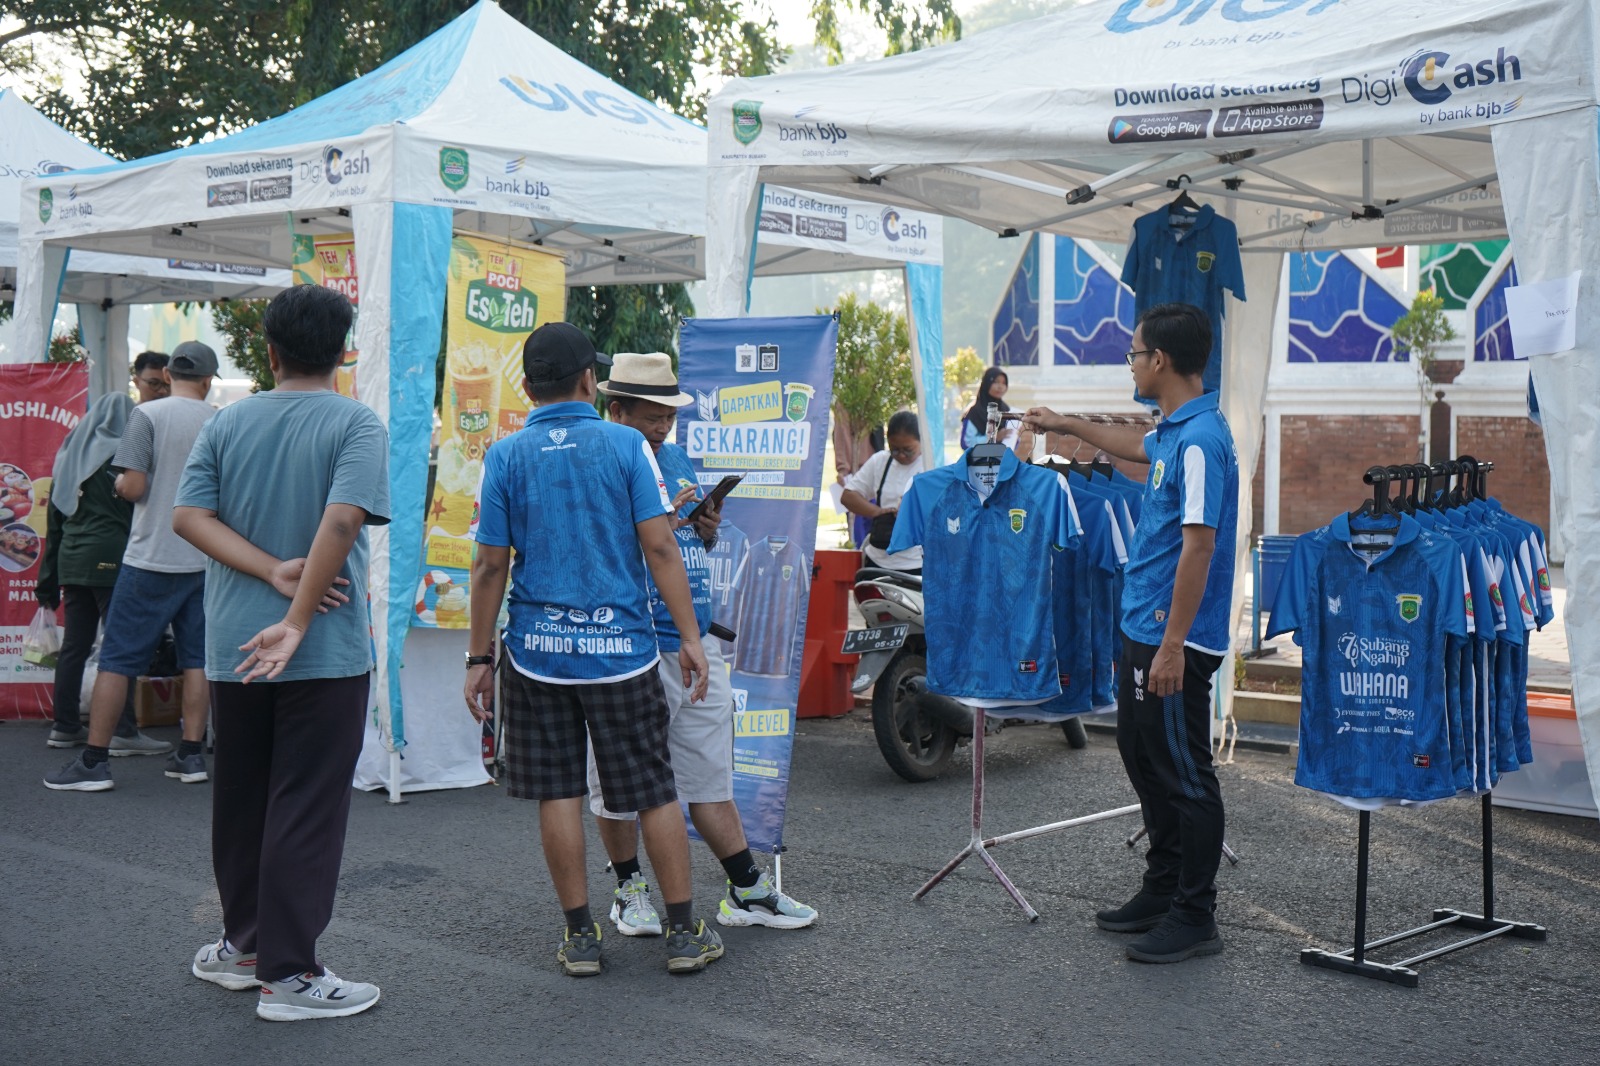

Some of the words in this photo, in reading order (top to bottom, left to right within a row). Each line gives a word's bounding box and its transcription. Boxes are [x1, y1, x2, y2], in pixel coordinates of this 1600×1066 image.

[1114, 82, 1215, 107] Download
[1244, 106, 1285, 117] Available
[1299, 102, 1314, 111] the
[1420, 112, 1435, 125] by
[1438, 106, 1472, 122] bank
[1475, 102, 1502, 119] bjb
[1137, 123, 1176, 138] Google
[1177, 121, 1202, 135] Play
[1241, 116, 1273, 132] App
[1275, 113, 1314, 127] Store
[779, 124, 817, 142] bank
[817, 123, 847, 144] bjb
[802, 149, 825, 158] Cabang
[826, 149, 849, 158] Subang
[206, 160, 250, 179] Download
[251, 156, 294, 173] sekarang
[260, 187, 274, 198] App
[273, 184, 289, 196] Store
[486, 176, 520, 194] bank
[524, 179, 550, 199] bjb
[218, 192, 235, 202] Google
[235, 191, 245, 201] Play
[78, 202, 93, 218] bjb
[798, 198, 848, 219] sekarang
[809, 225, 824, 237] App
[824, 226, 844, 238] Store
[319, 250, 338, 264] TEH
[490, 255, 504, 264] TEH
[488, 272, 519, 290] POCI
[468, 288, 490, 321] Es
[502, 292, 534, 328] Teh
[722, 391, 780, 415] DAPATKAN
[460, 415, 470, 430] Es
[474, 414, 489, 430] Teh
[692, 426, 805, 455] SEKARANG!
[705, 456, 735, 467] PERSIKAS
[736, 457, 761, 468] OFFICIAL
[762, 458, 784, 468] JERSEY
[761, 474, 784, 484] ROYONG
[754, 487, 781, 498] BERLAGA
[783, 489, 791, 497] DI
[792, 488, 806, 498] LIGA
[807, 489, 812, 499] 2
[430, 539, 450, 550] Lemon
[435, 551, 450, 562] Iced
[451, 553, 464, 563] Tea
[535, 621, 577, 634] FORUM
[586, 625, 623, 635] BUMD
[524, 633, 573, 653] APINDO
[577, 637, 633, 654] SUBANG
[847, 632, 854, 642] T
[1360, 637, 1410, 658] Subang
[1361, 650, 1406, 668] Ngahiji
[1340, 672, 1409, 699] WAHANA
[750, 713, 785, 733] LEVEL
